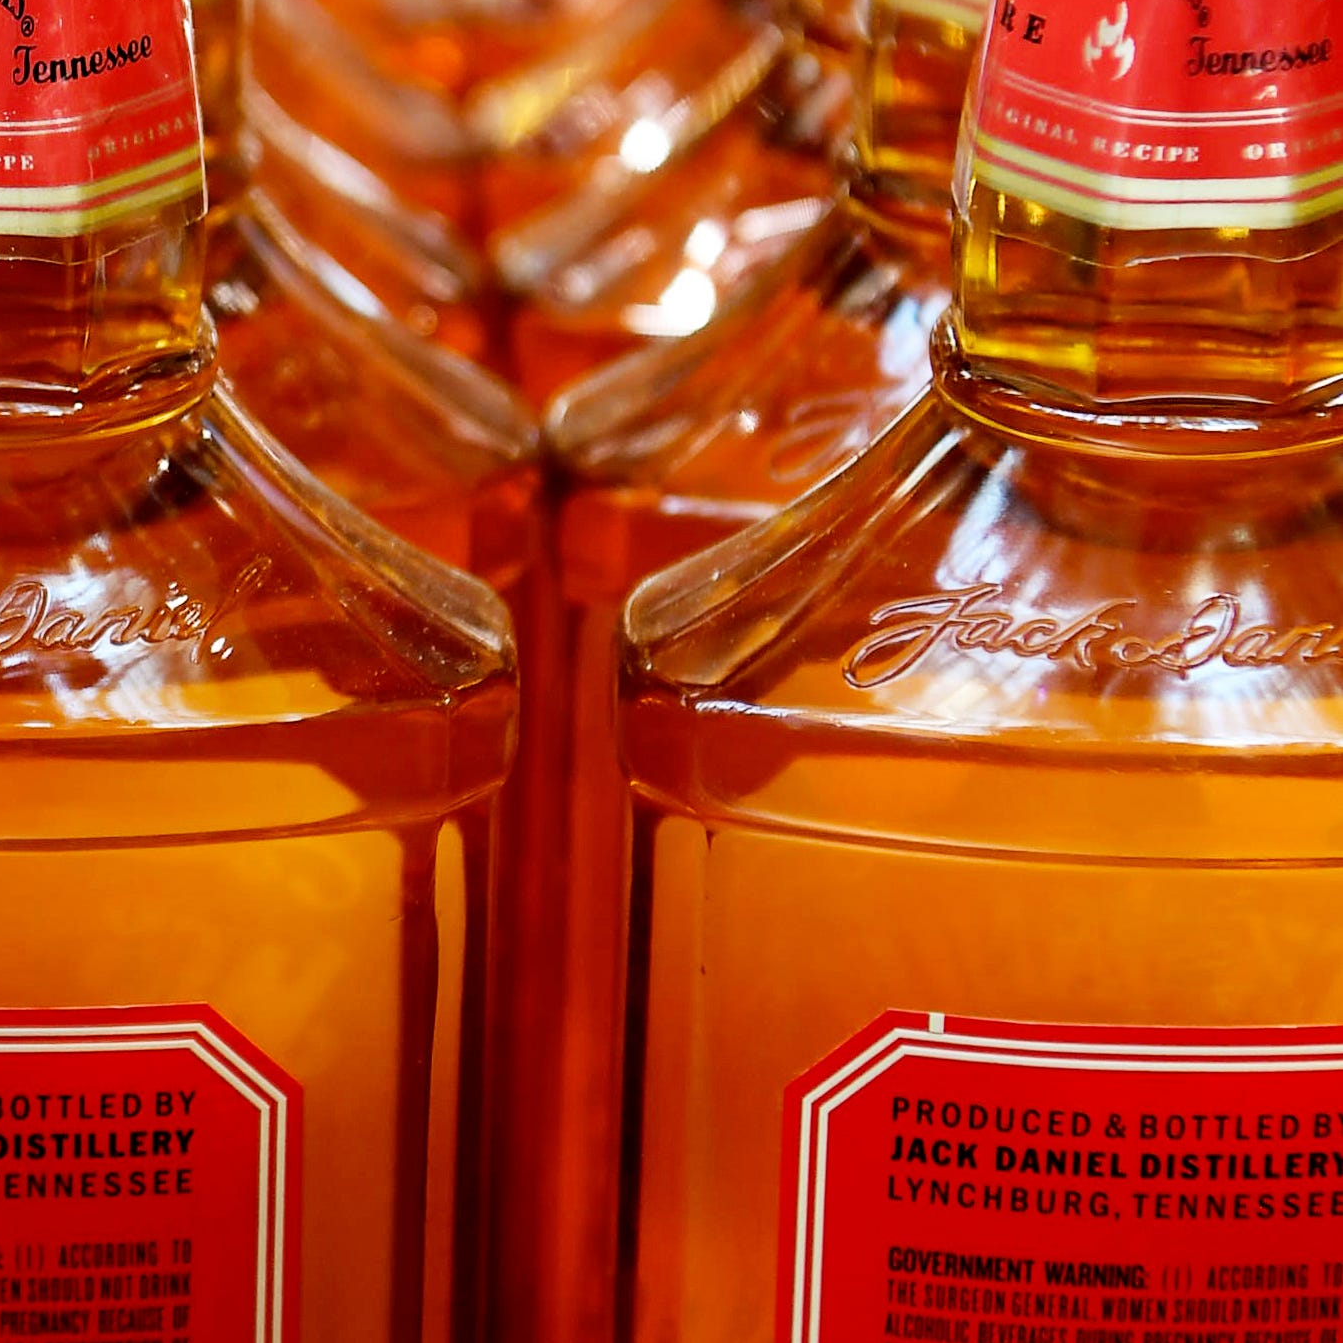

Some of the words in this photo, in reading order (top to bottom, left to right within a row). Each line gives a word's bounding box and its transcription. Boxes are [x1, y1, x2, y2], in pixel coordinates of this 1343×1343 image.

[999, 0, 1047, 44] RE
[13, 35, 153, 86] Tennessee
[1187, 35, 1332, 77] Tennessee
[994, 102, 1078, 145] IGINAL
[1091, 135, 1200, 162] RECIPE
[841, 582, 1138, 688] Jack
[155, 1090, 196, 1117] BY
[892, 1096, 1091, 1137] PRODUCED
[1105, 1116, 1127, 1139] &
[1140, 1114, 1300, 1141] BOTTLED
[891, 1135, 978, 1169] JACK
[996, 1145, 1127, 1178] DANIEL
[1140, 1151, 1343, 1180] DISTILLERY
[888, 1175, 1121, 1221] LYNCHBURG,
[1133, 1192, 1343, 1220] TENNESSEE
[59, 1241, 157, 1269] ACCORDING
[172, 1239, 192, 1264] TO
[887, 1245, 1035, 1284] GOVERNMENT
[1044, 1260, 1149, 1290] WARNING:
[1161, 1264, 1192, 1293] (1)
[1207, 1263, 1308, 1291] ACCORDING
[1323, 1262, 1343, 1289] TO
[28, 1276, 94, 1302] SHOULD
[101, 1275, 133, 1300] NOT
[139, 1273, 191, 1299] DRINK
[887, 1278, 917, 1307] THE
[923, 1282, 1006, 1315] SURGEON
[1101, 1297, 1167, 1323] WOMEN
[1172, 1298, 1243, 1324] SHOULD
[1249, 1297, 1281, 1323] NOT
[1287, 1296, 1341, 1322] DRINK
[0, 1310, 89, 1335] PREGNANCY
[173, 1305, 189, 1330] OF
